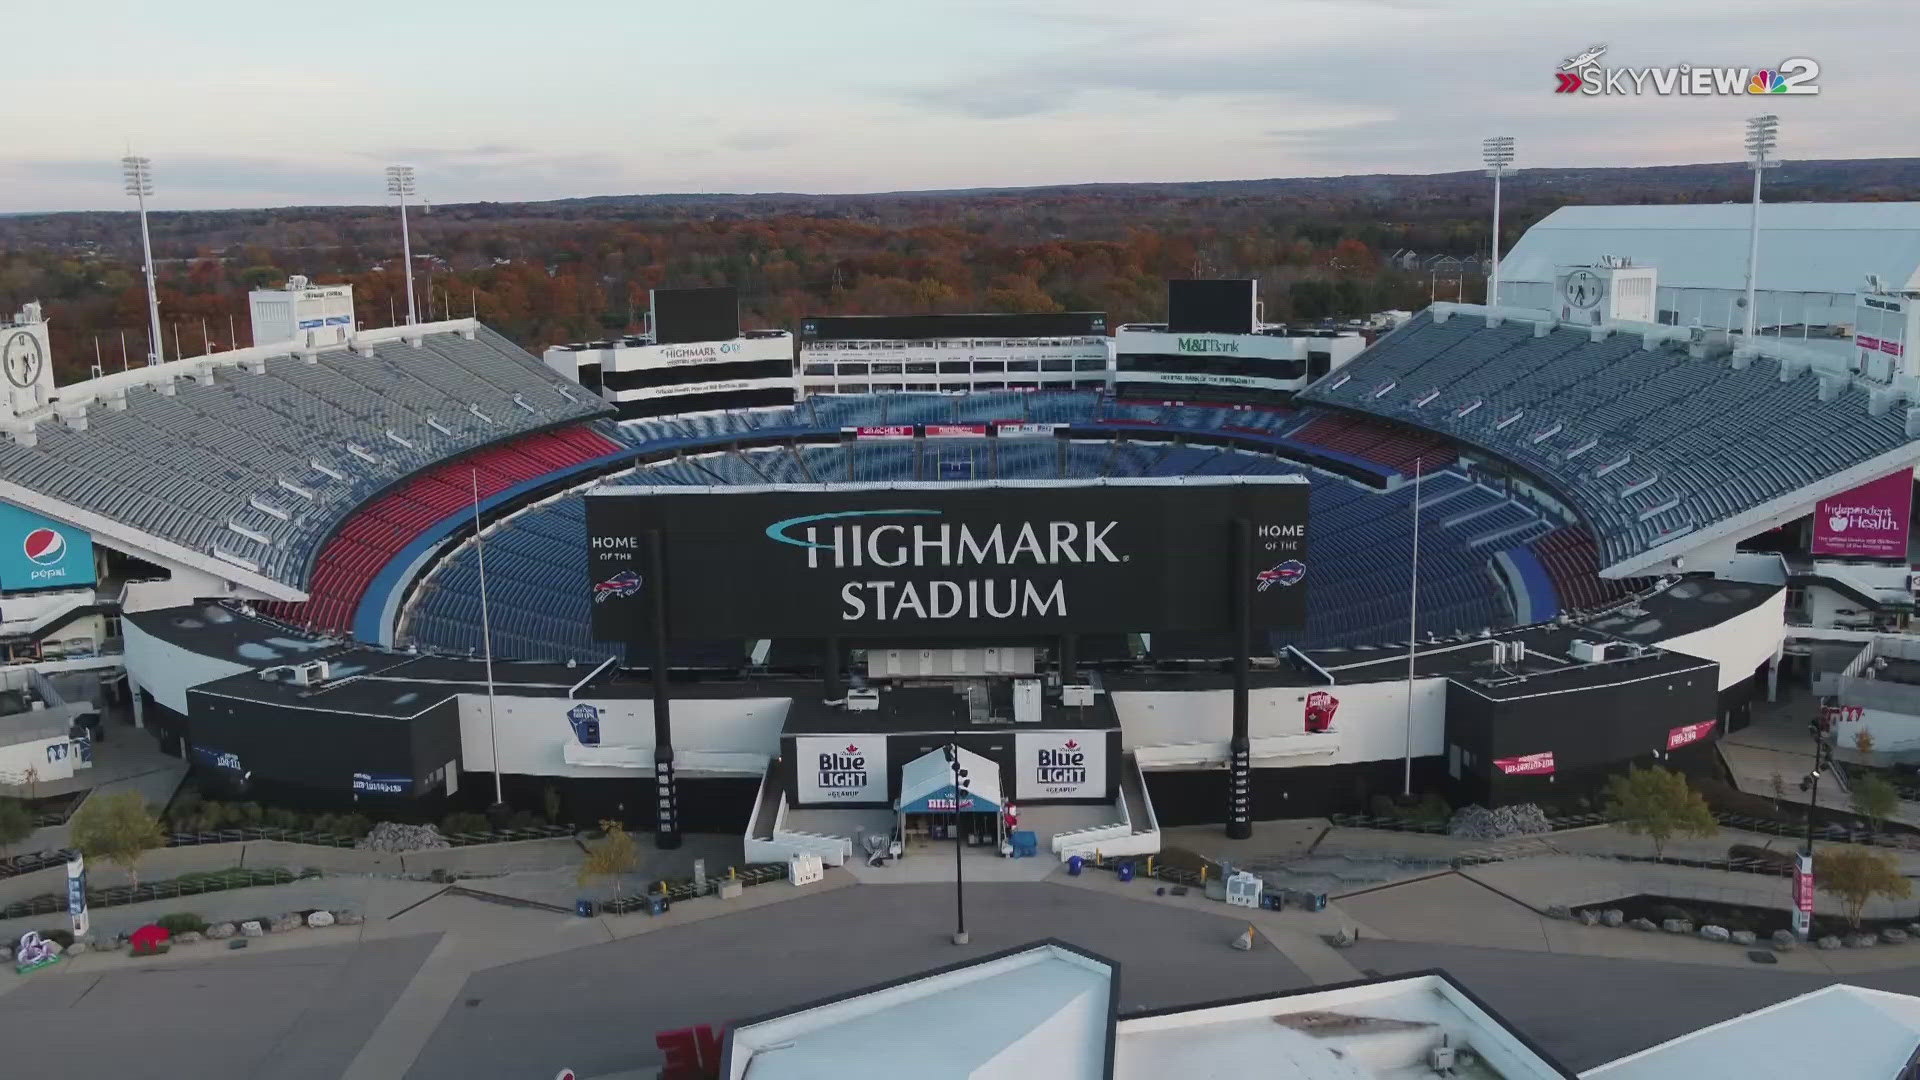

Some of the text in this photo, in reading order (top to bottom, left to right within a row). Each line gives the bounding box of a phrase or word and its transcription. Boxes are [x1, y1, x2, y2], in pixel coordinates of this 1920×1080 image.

[1178, 337, 1239, 353] M&T Bank
[665, 347, 717, 359] HIGHMARK
[1824, 503, 1892, 517] Independent
[1258, 525, 1305, 537] HOME
[592, 536, 638, 549] HOME
[807, 521, 1120, 568] HIGHMARK
[1265, 541, 1298, 550] OF THE
[599, 552, 632, 560] OF THE
[31, 567, 66, 580] pepsi
[841, 579, 1068, 620] STADIUM
[819, 753, 865, 770] Blue
[1038, 749, 1084, 766] Blue
[819, 772, 865, 787] LIGHT
[1038, 769, 1084, 783] LIGHT
